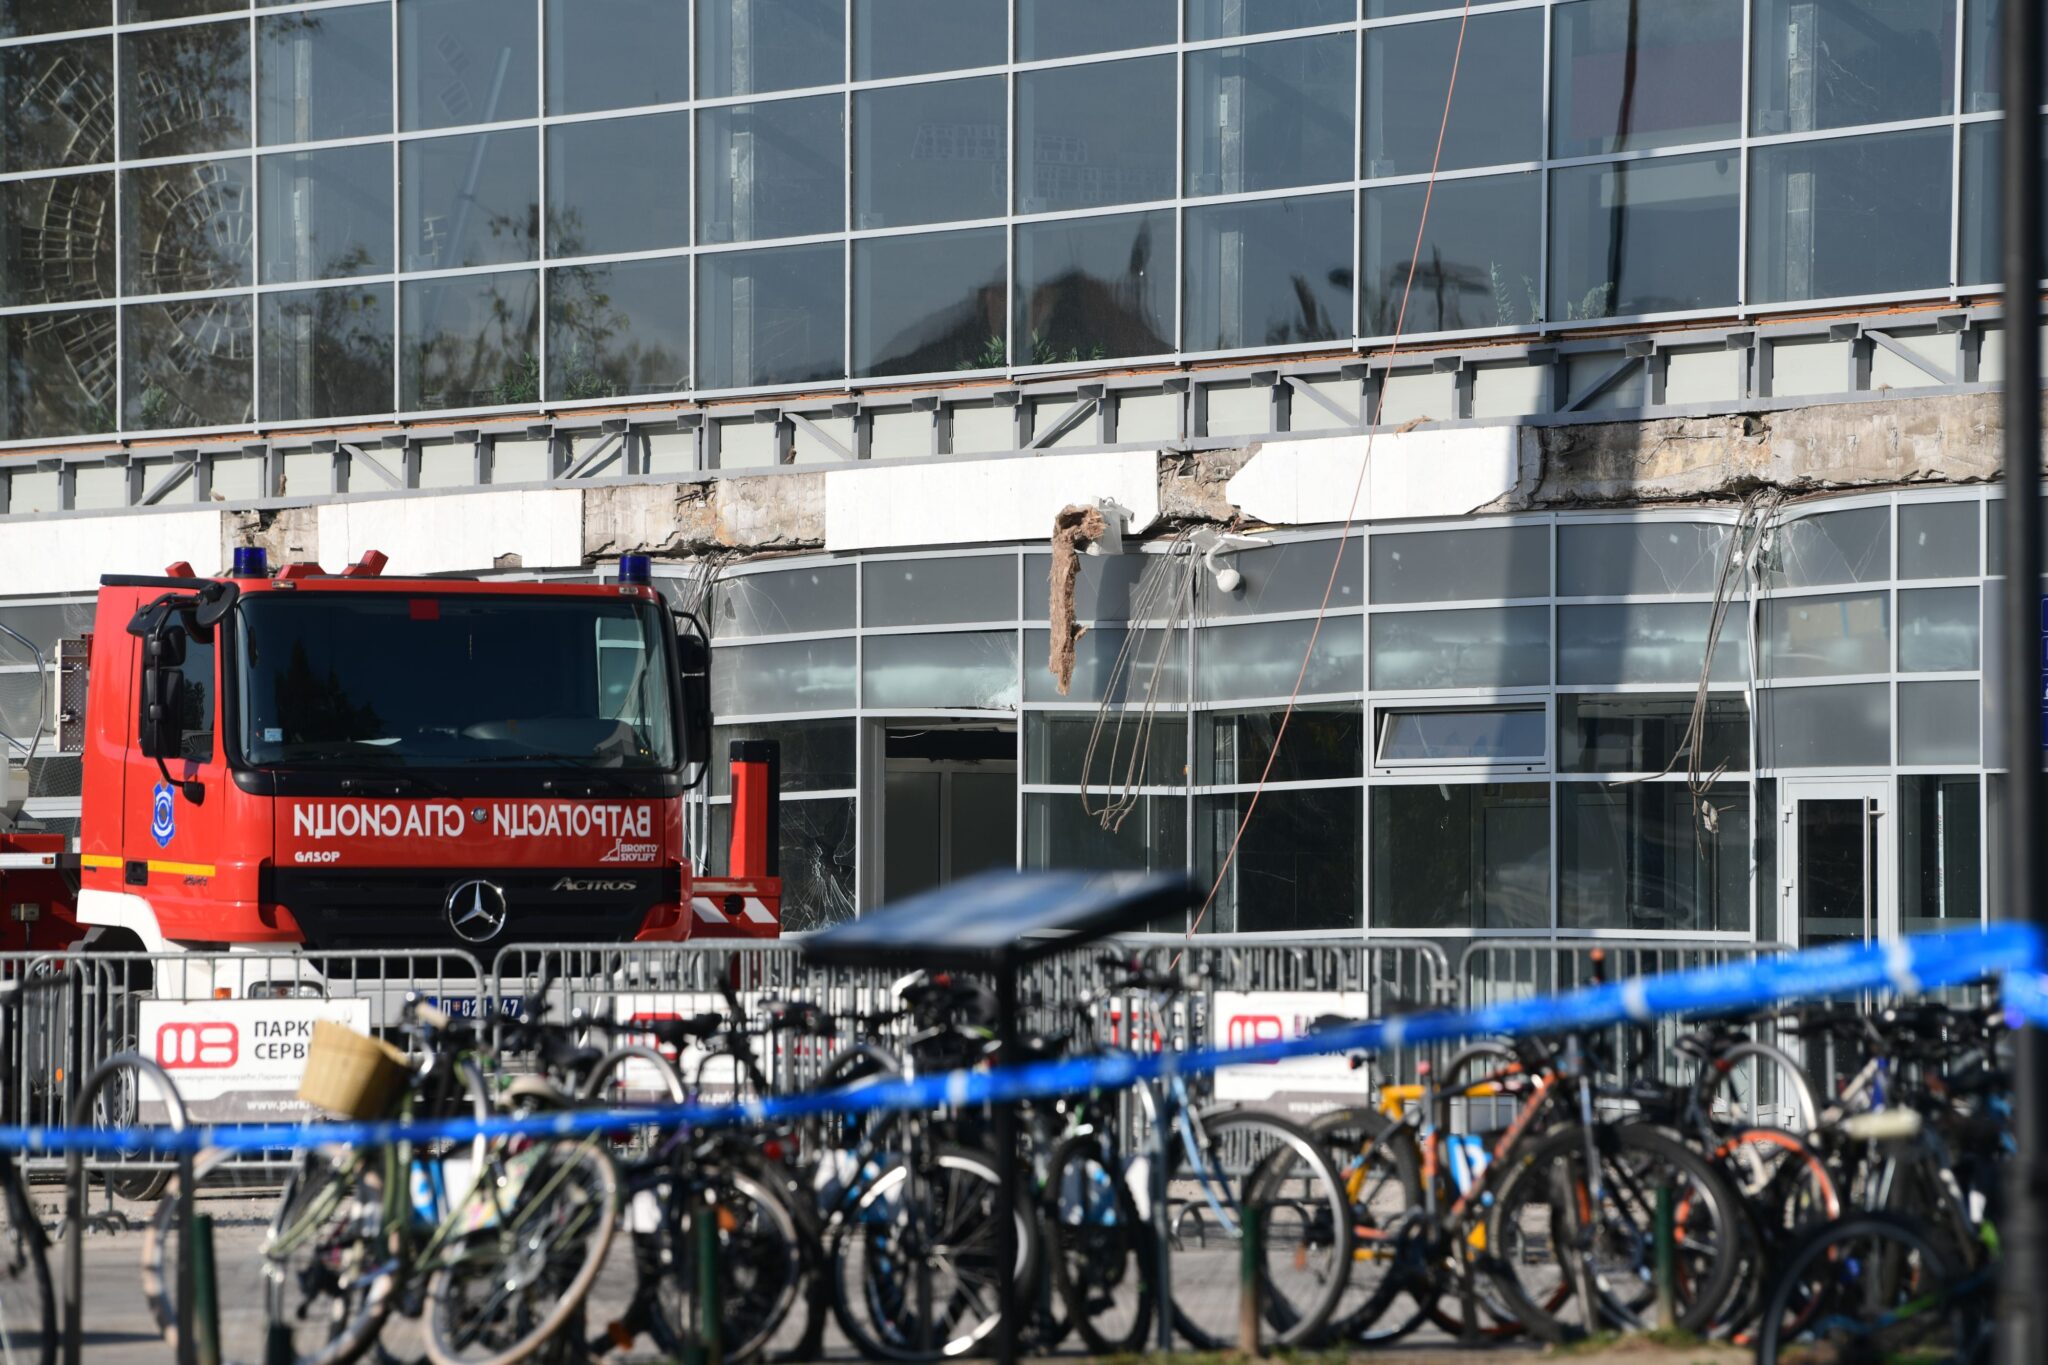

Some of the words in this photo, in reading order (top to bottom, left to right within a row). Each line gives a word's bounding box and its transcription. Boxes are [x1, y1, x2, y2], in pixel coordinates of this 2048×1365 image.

[621, 844, 657, 853] BRONTO
[294, 851, 340, 862] GASOP
[621, 853, 656, 862] SKYLIFT
[254, 1020, 351, 1037] ПАРК
[254, 1042, 311, 1060] СЕРВ
